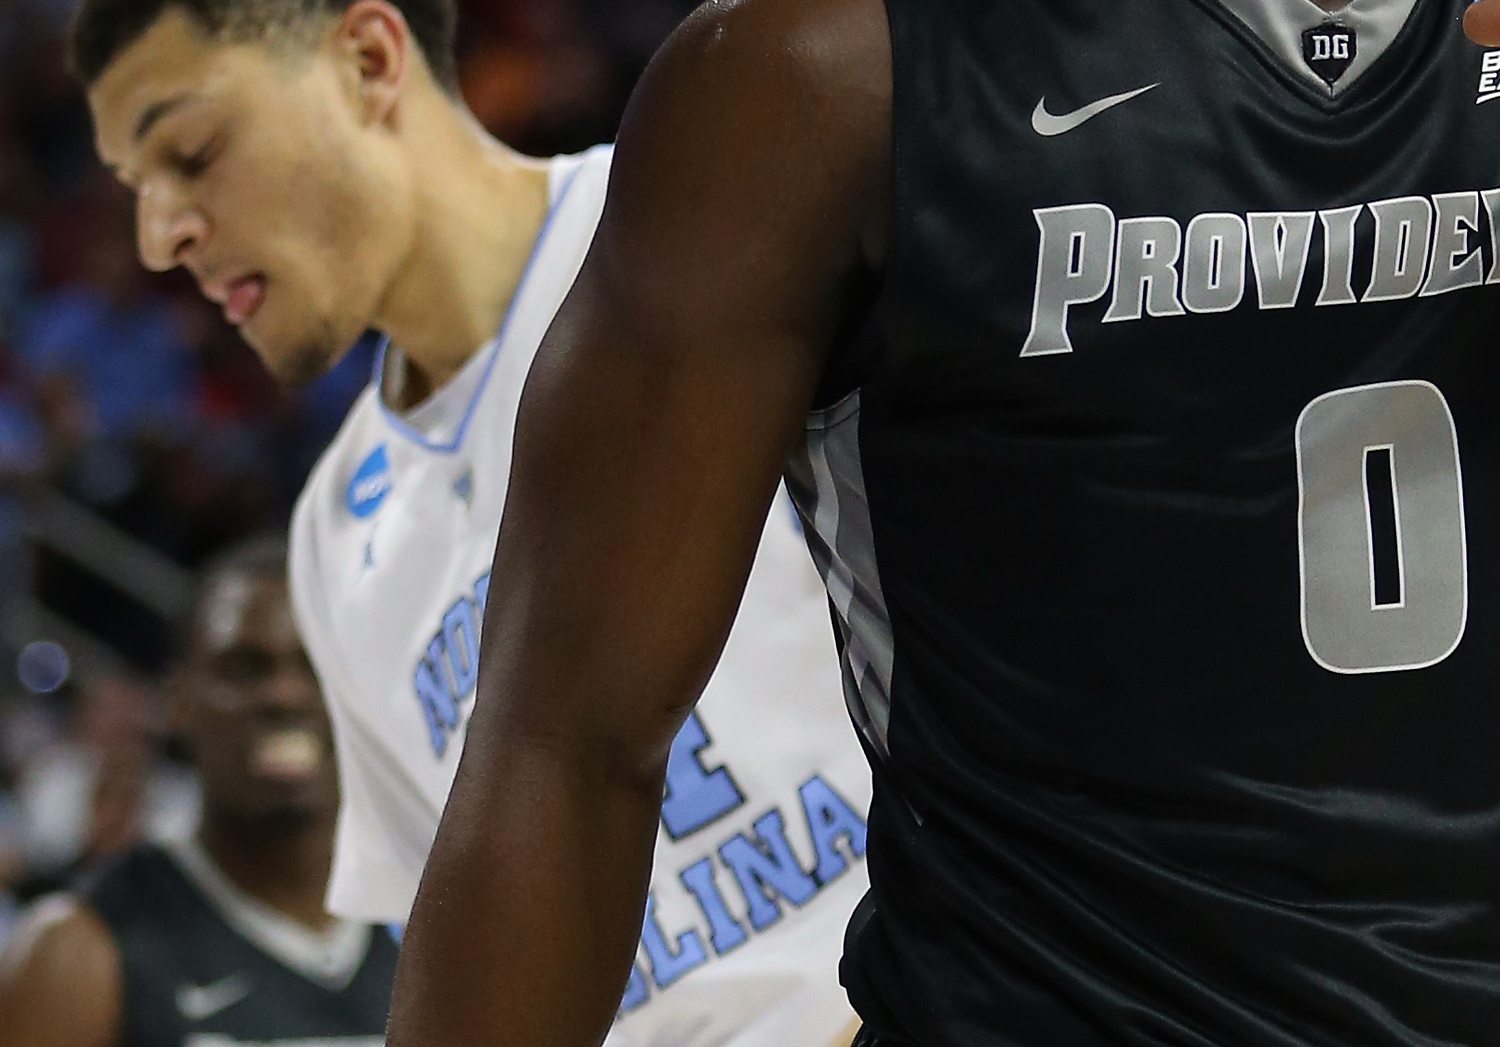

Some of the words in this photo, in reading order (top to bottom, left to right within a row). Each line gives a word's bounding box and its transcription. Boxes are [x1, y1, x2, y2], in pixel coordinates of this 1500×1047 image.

[1311, 34, 1349, 60] DG
[1295, 379, 1468, 674] 0
[618, 775, 868, 1017] LINA
